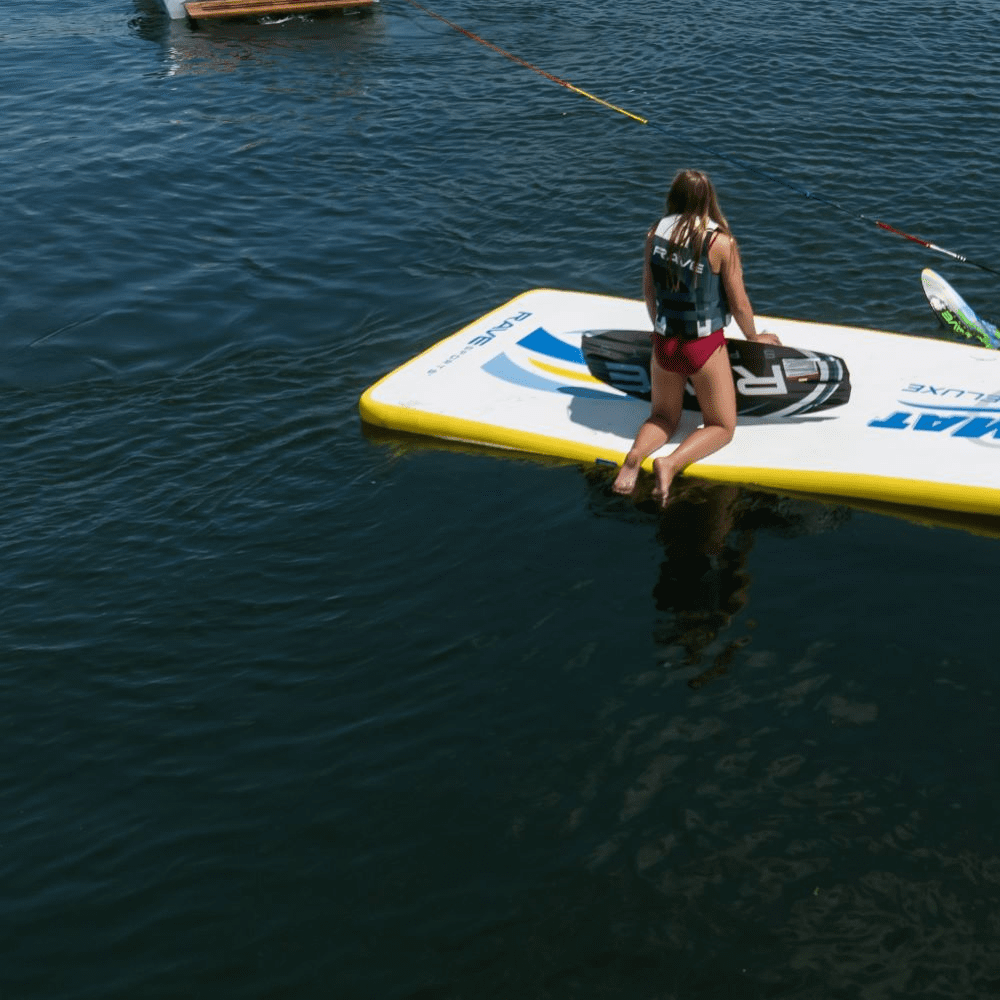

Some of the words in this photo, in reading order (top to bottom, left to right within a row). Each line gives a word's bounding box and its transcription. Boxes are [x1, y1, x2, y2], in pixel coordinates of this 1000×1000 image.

[653, 245, 704, 274] RAVE
[468, 311, 533, 347] RAVE
[605, 362, 787, 395] RE
